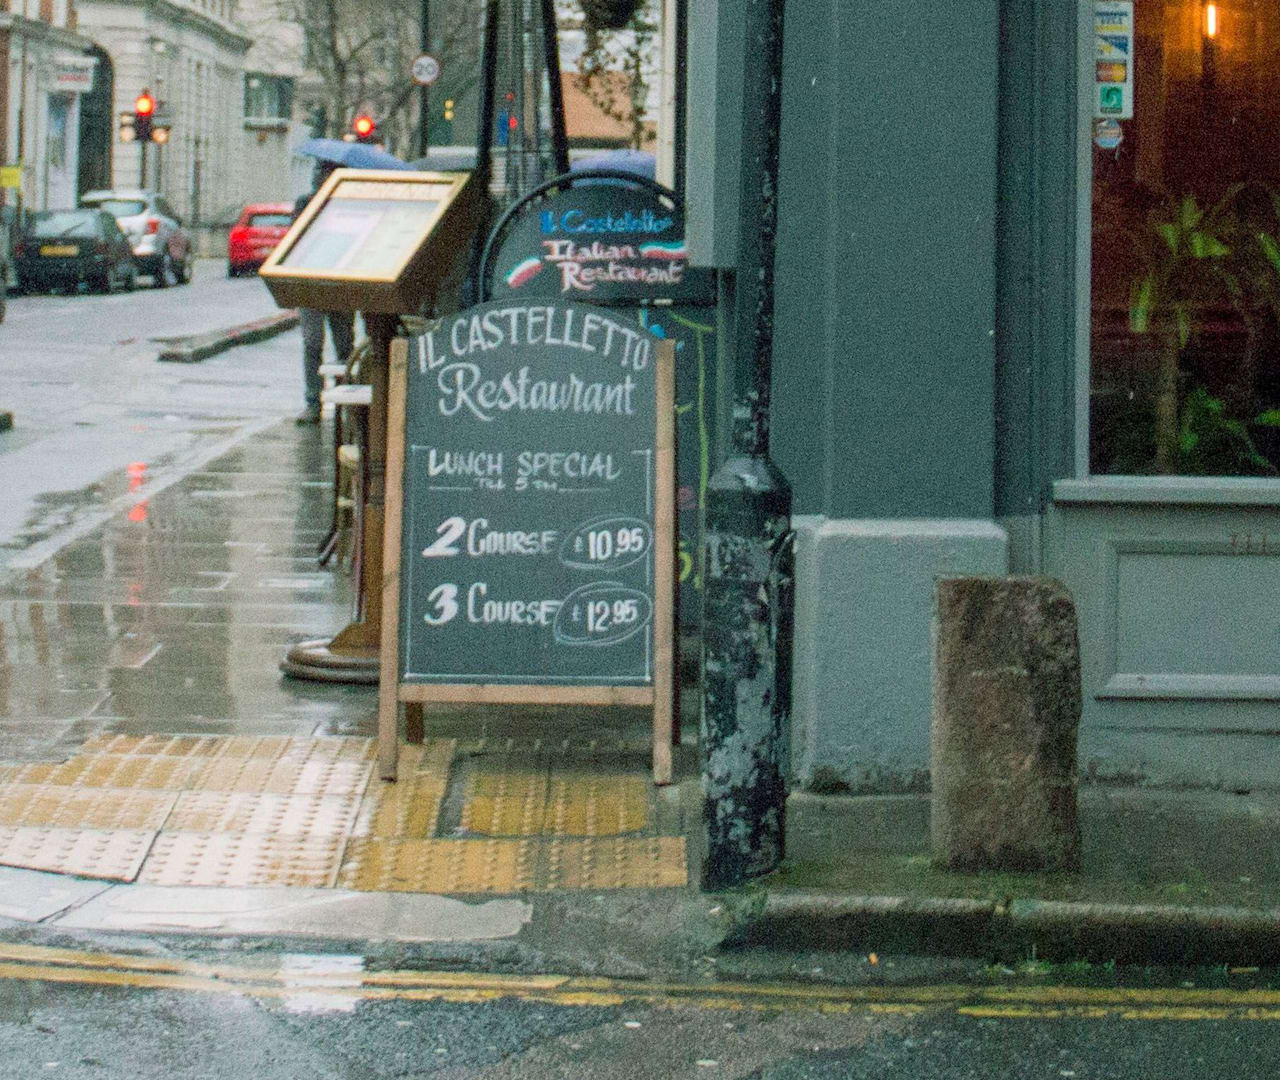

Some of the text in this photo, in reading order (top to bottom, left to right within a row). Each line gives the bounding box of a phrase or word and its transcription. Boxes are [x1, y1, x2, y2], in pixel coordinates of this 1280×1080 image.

[414, 62, 437, 76] 20
[542, 240, 637, 261] Italian
[557, 261, 684, 293] Restaurant
[419, 306, 650, 374] IL CASTELLETTO
[438, 362, 636, 422] Restaurant
[428, 448, 621, 481] LUNCH SPECIAL
[423, 516, 466, 558] 2
[424, 582, 459, 625] 3
